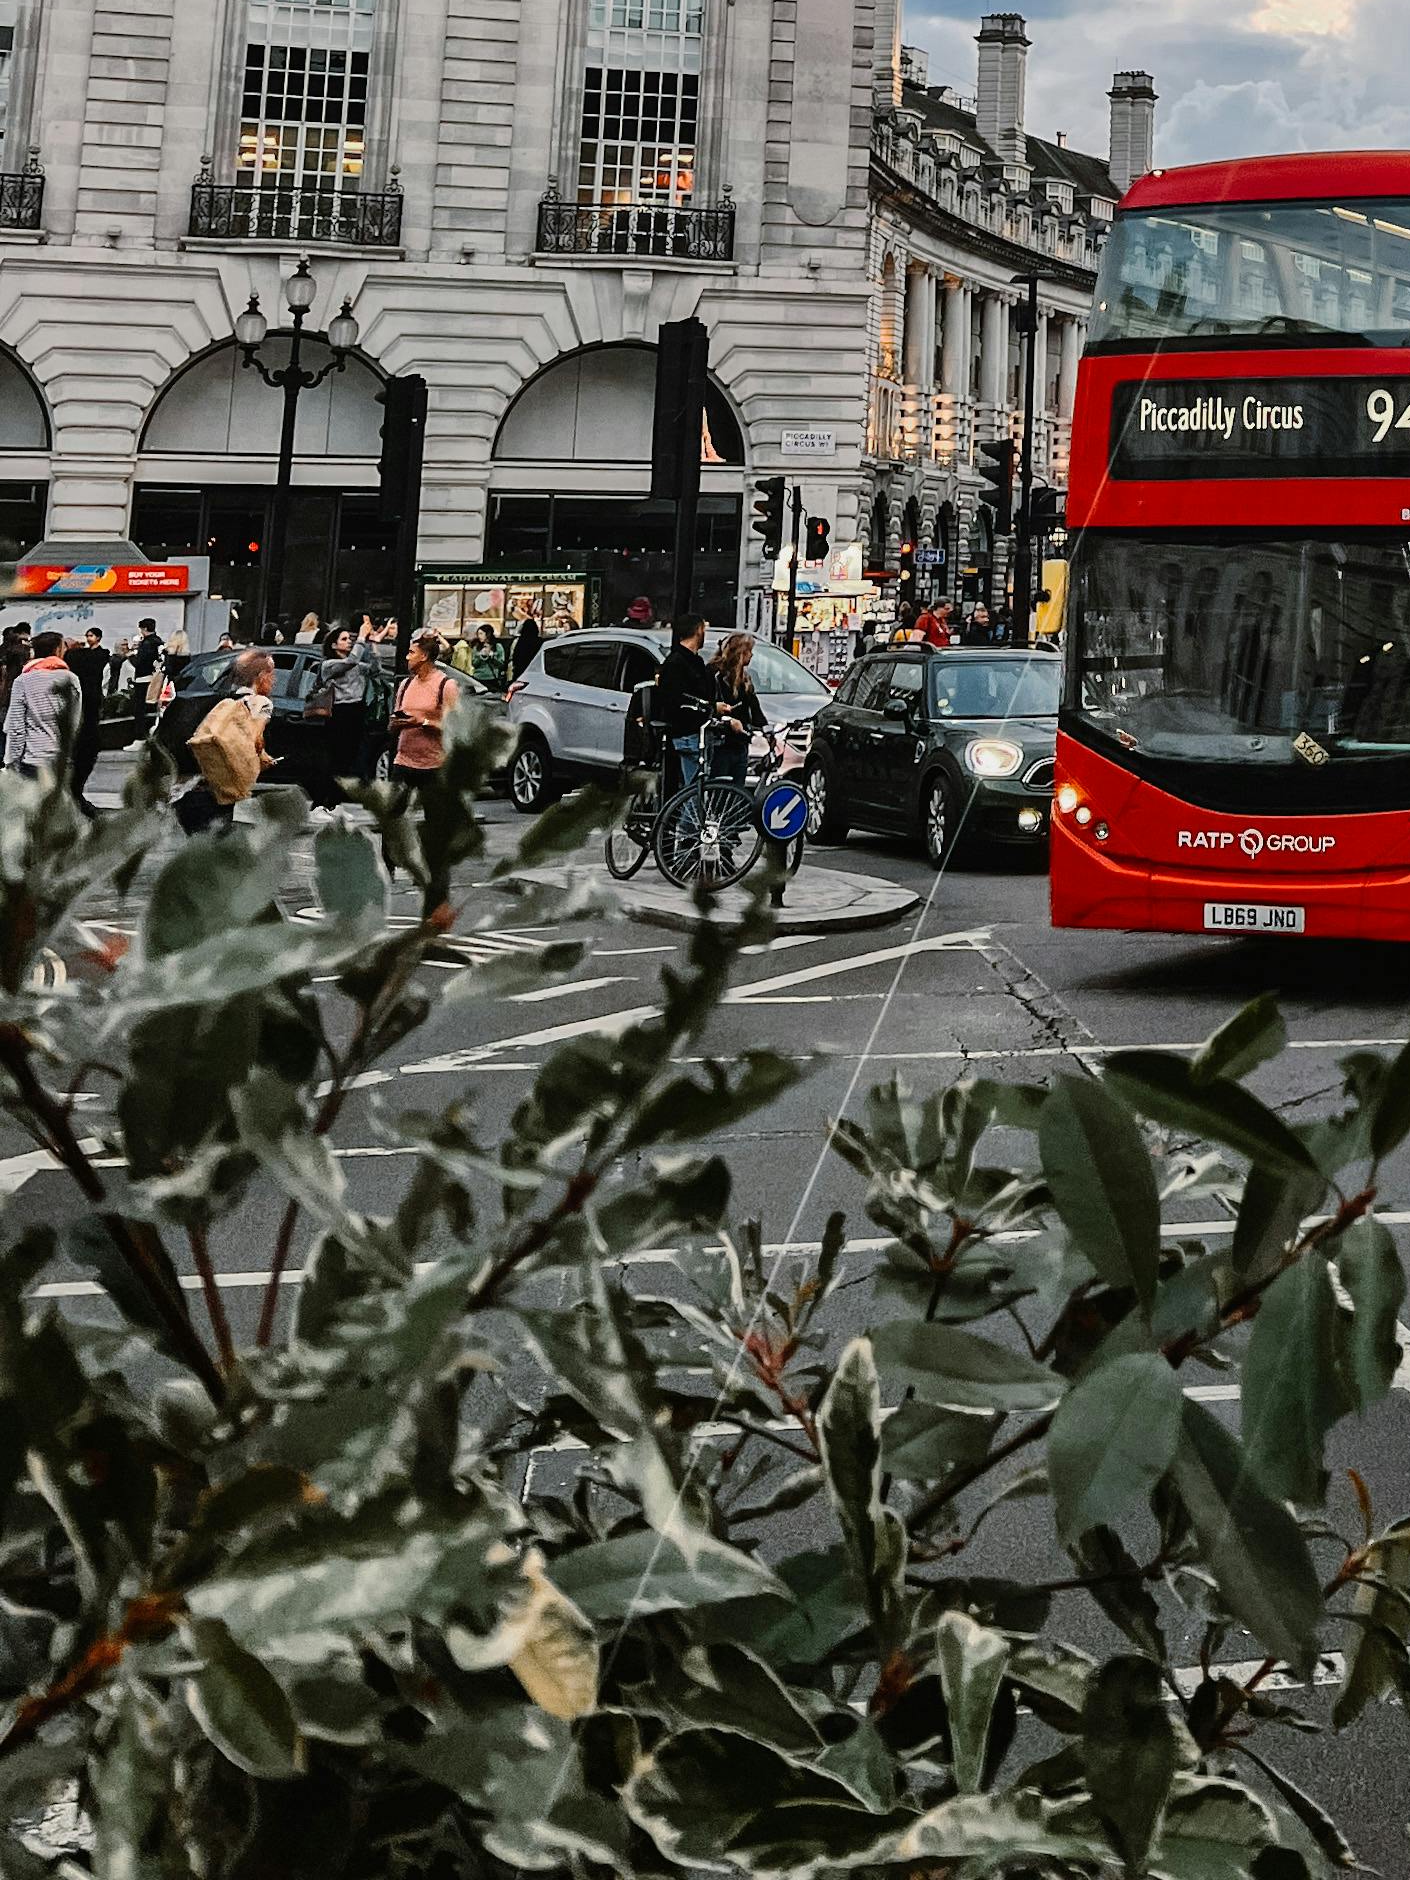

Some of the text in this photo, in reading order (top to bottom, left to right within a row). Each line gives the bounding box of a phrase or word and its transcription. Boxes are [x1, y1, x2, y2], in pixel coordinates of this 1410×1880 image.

[1139, 396, 1236, 440] Piccadilly
[1242, 396, 1304, 431] Circus
[785, 432, 832, 440] PICCADILLY
[1295, 735, 1324, 765] 360
[1178, 831, 1336, 853] RATP GROUP
[1212, 906, 1257, 926] LB69
